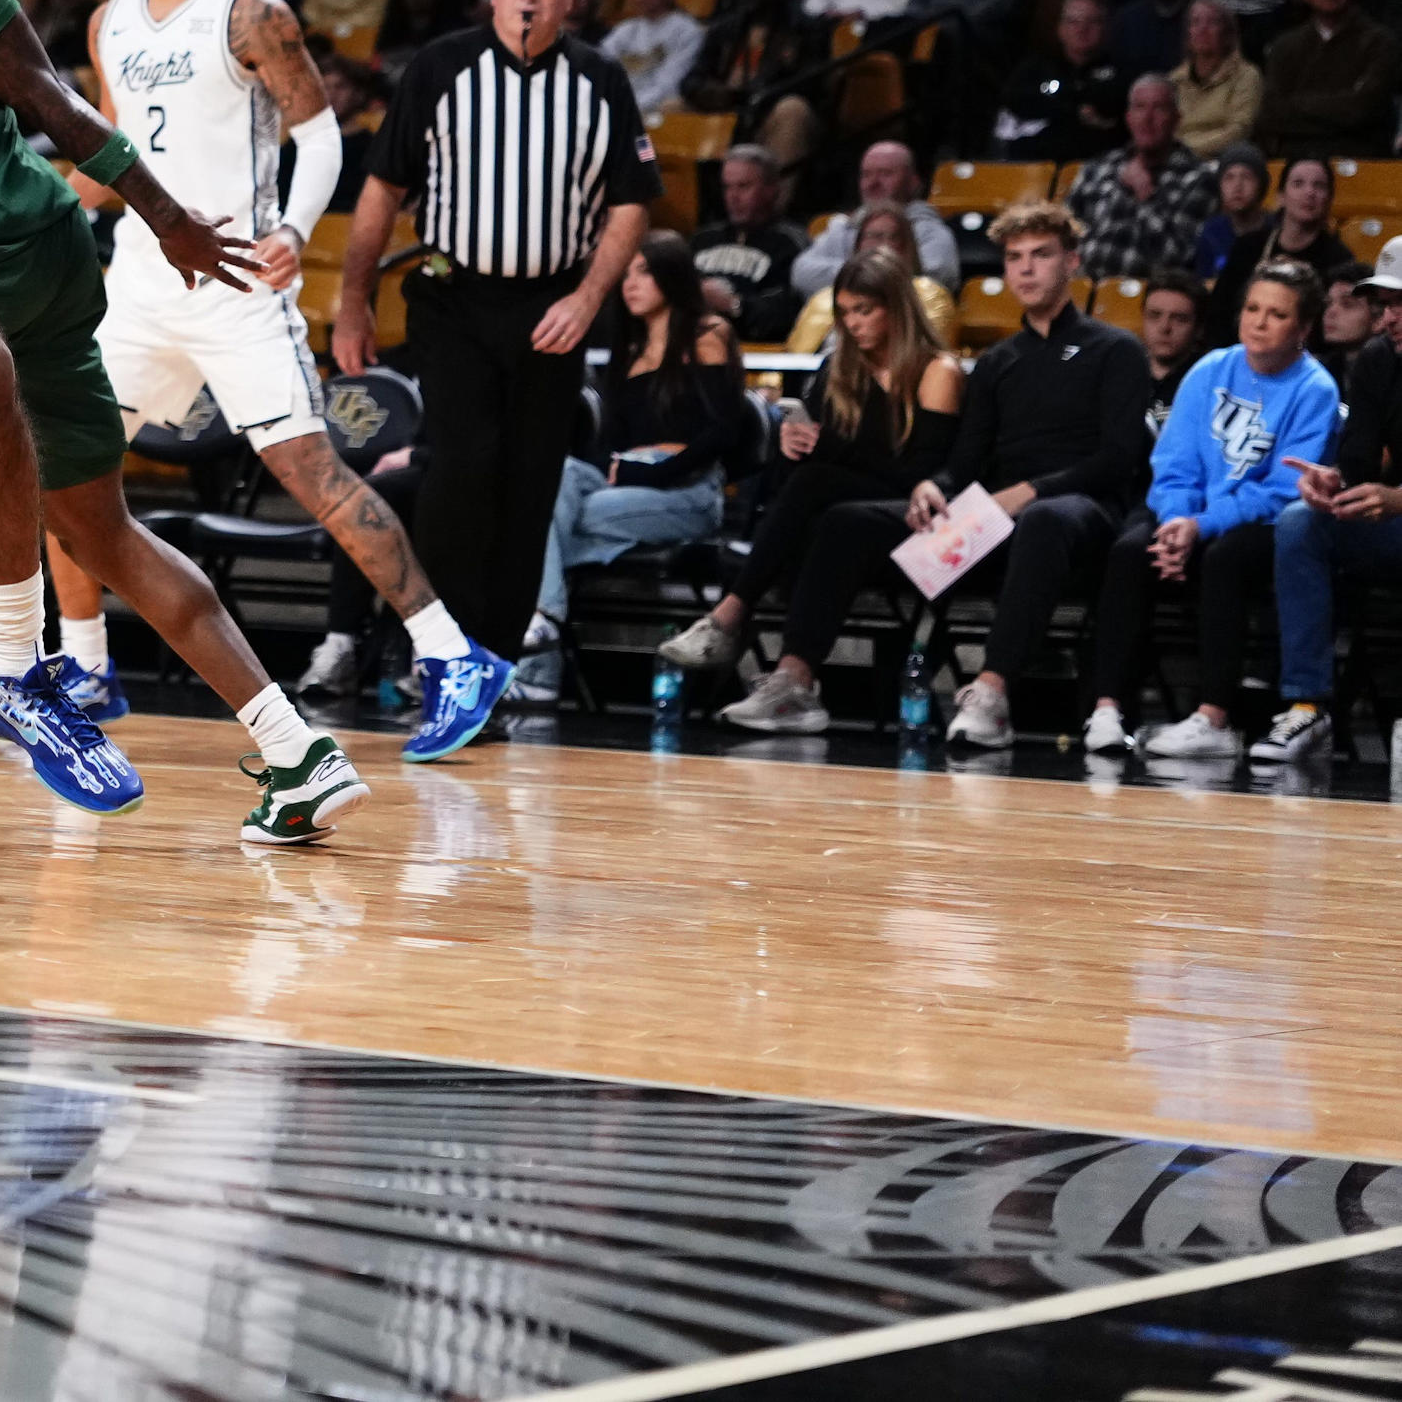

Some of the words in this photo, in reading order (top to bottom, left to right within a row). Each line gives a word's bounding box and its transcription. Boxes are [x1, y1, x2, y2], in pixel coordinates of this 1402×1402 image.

[116, 49, 196, 94] Knights
[148, 106, 165, 152] 2
[326, 384, 390, 448] UCF
[1212, 388, 1276, 480] UCF
